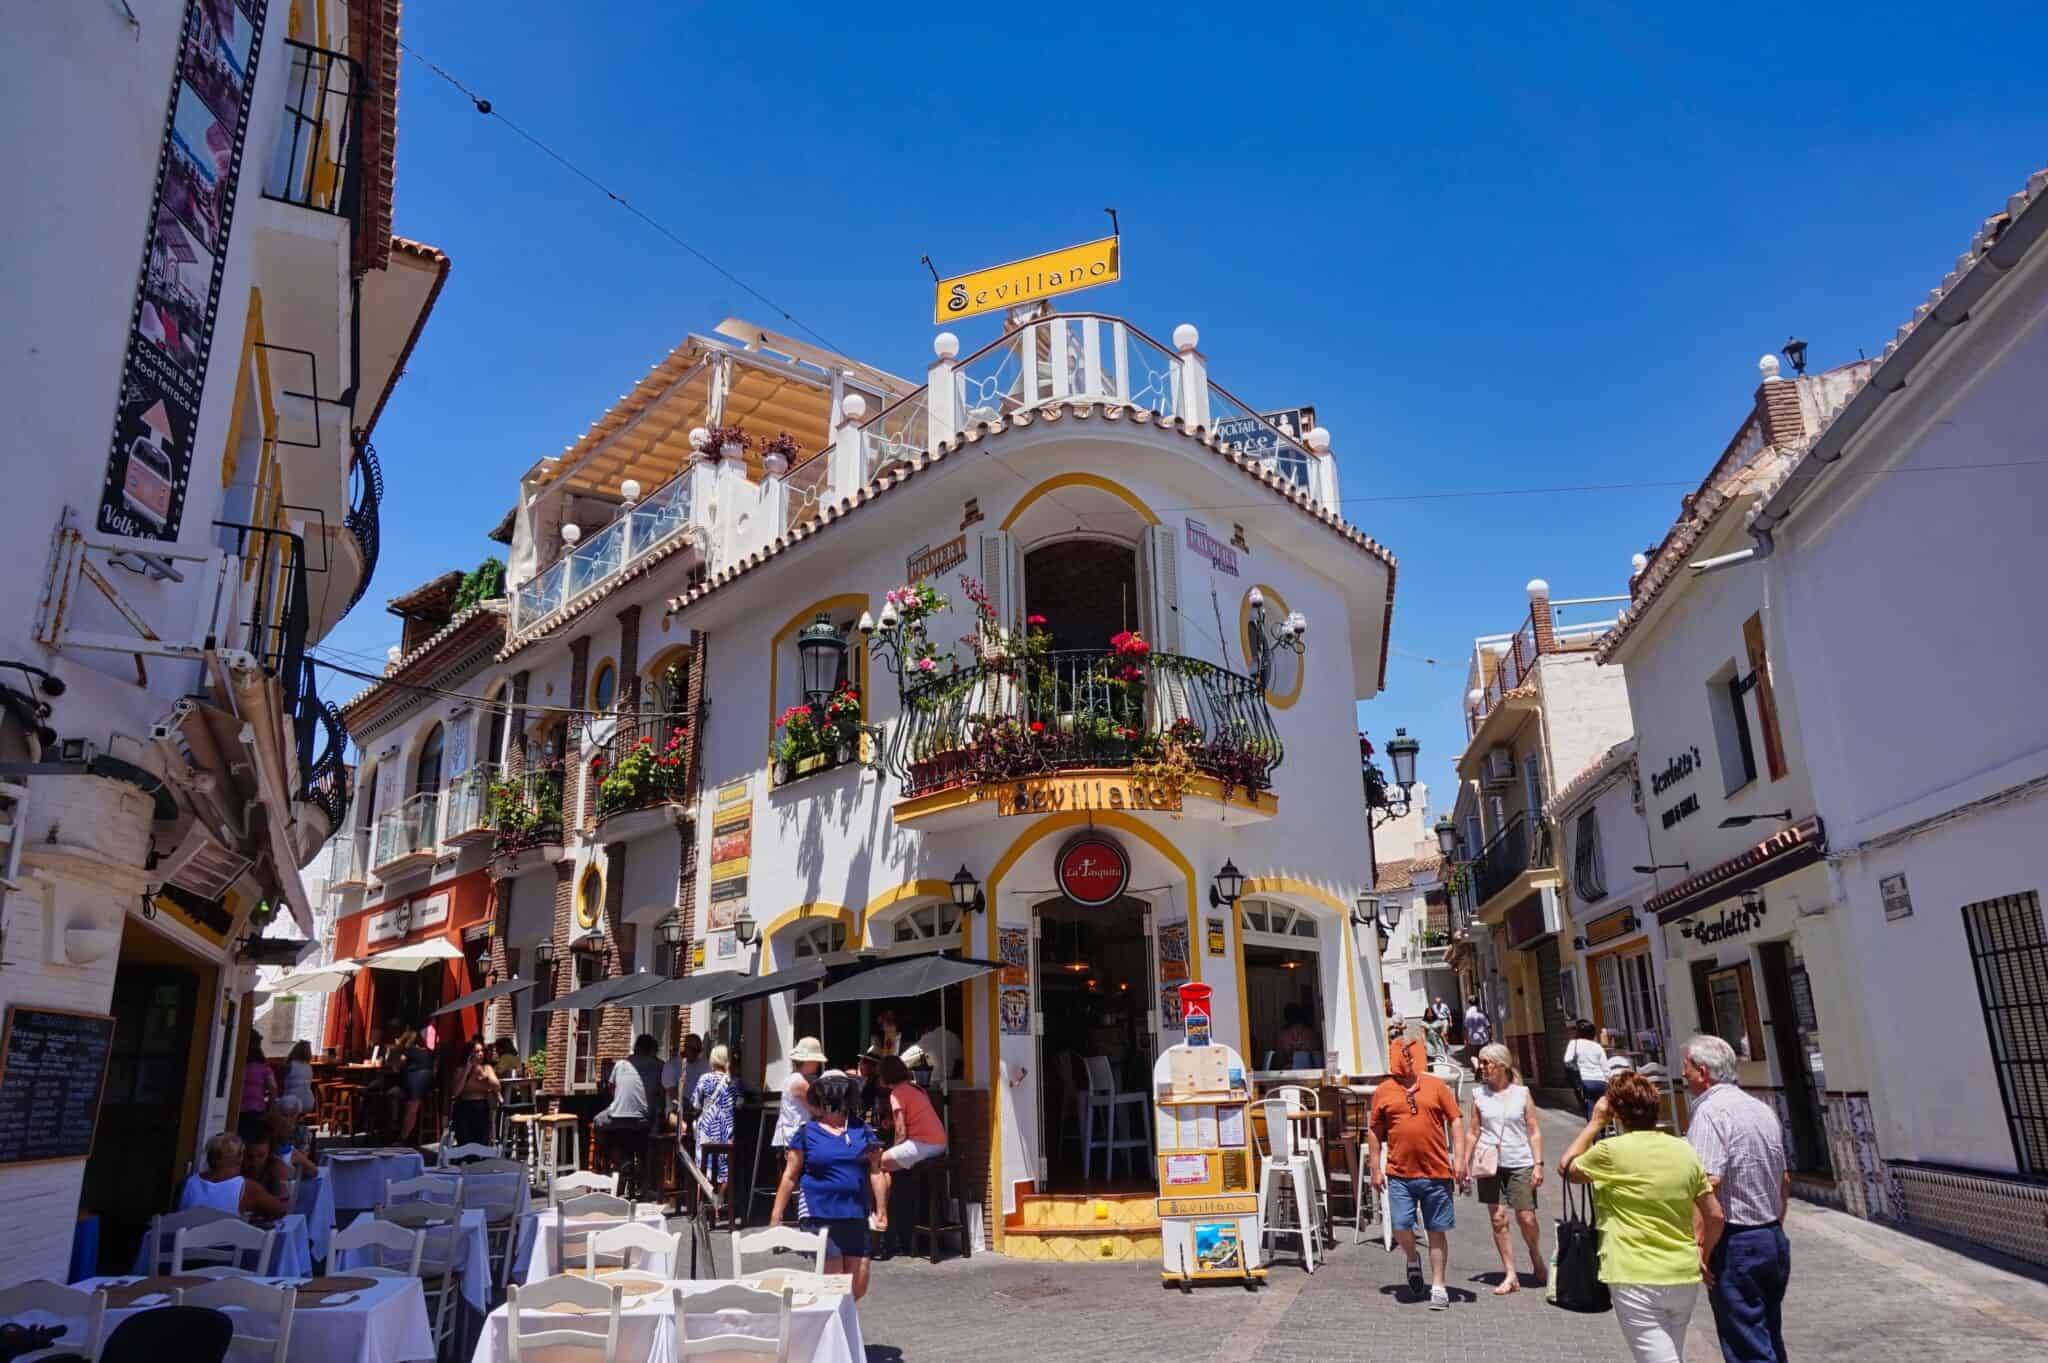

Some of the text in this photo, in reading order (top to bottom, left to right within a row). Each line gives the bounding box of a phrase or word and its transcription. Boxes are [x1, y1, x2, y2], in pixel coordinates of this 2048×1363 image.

[948, 261, 1107, 312] Sevillano
[134, 355, 191, 411] Roof Terrace
[138, 340, 193, 395] Cocktail Bar
[1216, 419, 1257, 438] OCKTAIL
[1696, 906, 1761, 944] Scarlettas
